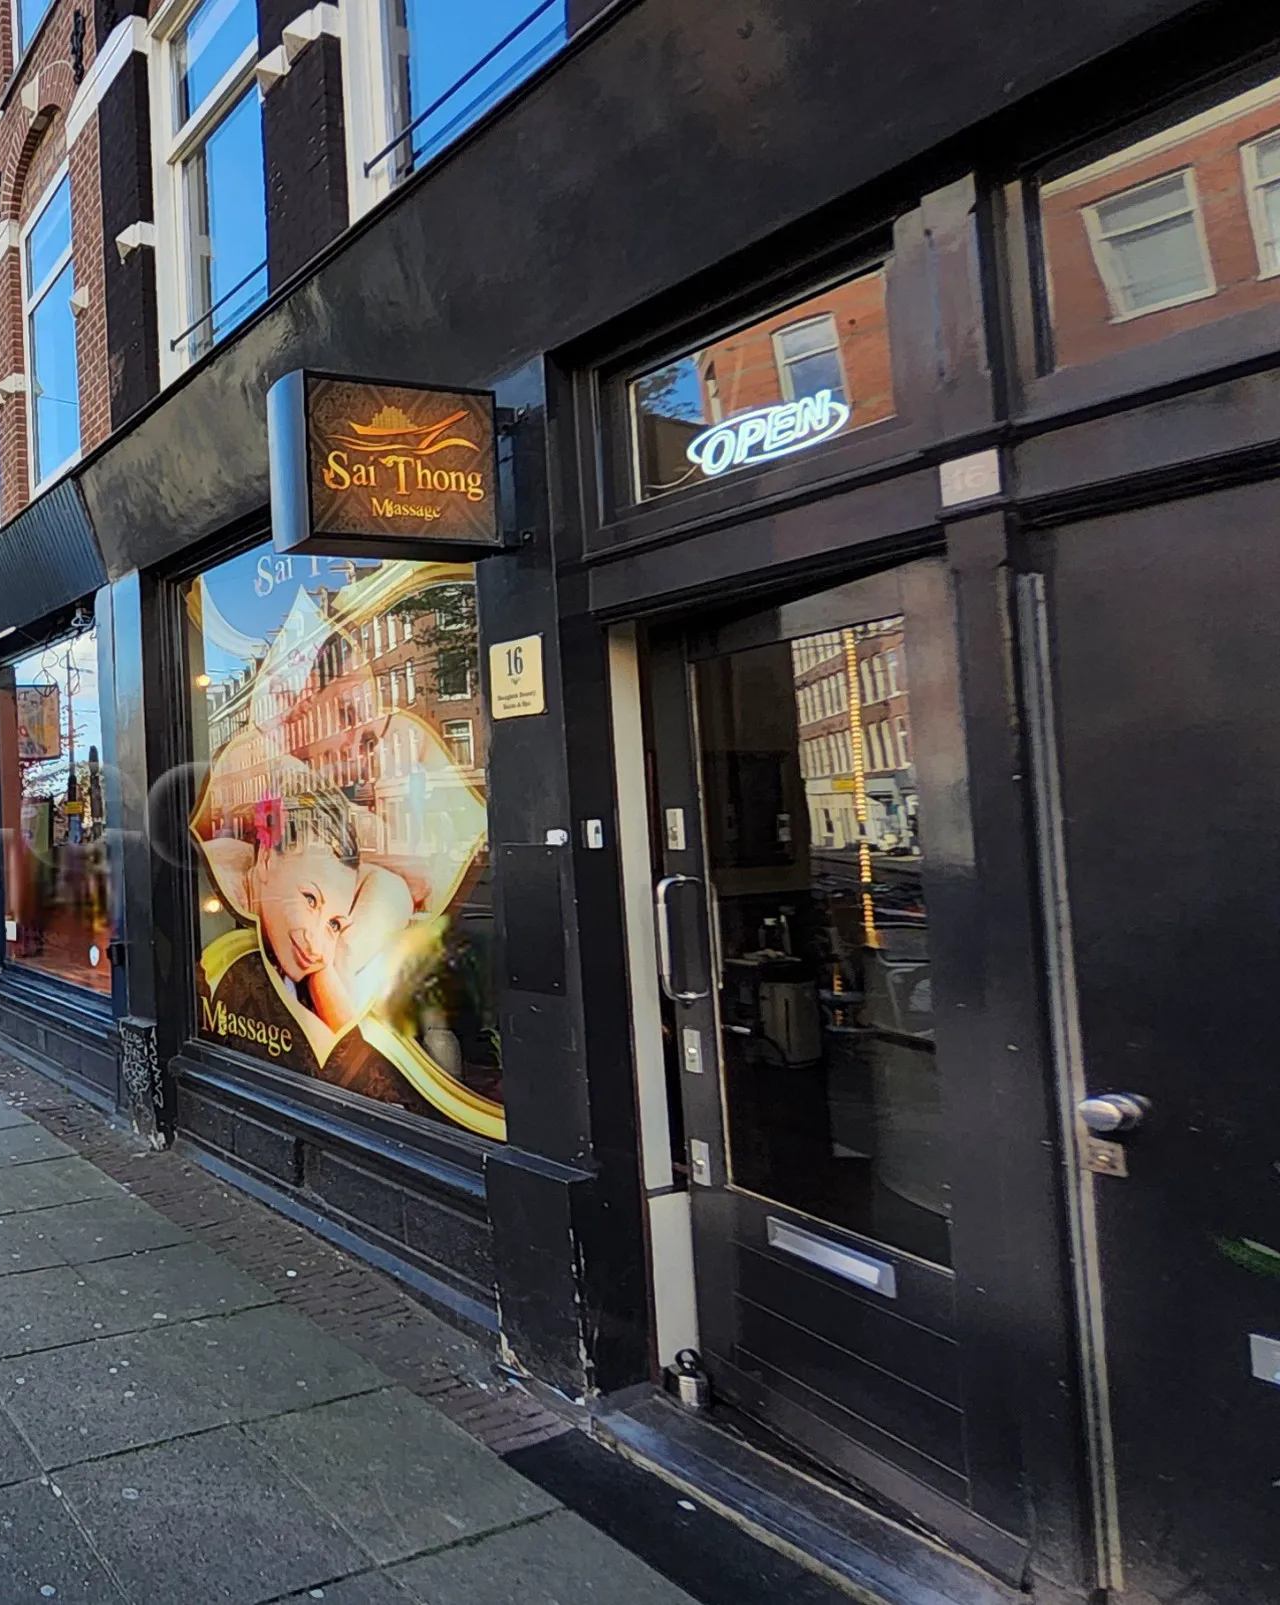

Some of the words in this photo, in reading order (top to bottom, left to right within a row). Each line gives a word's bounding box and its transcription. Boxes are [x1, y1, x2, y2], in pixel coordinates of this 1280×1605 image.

[701, 390, 832, 475] OPEN
[323, 450, 376, 490] Sai
[378, 455, 484, 502] Thong
[372, 497, 441, 520] Massage
[506, 646, 523, 676] 16
[200, 995, 293, 1057] Massage
